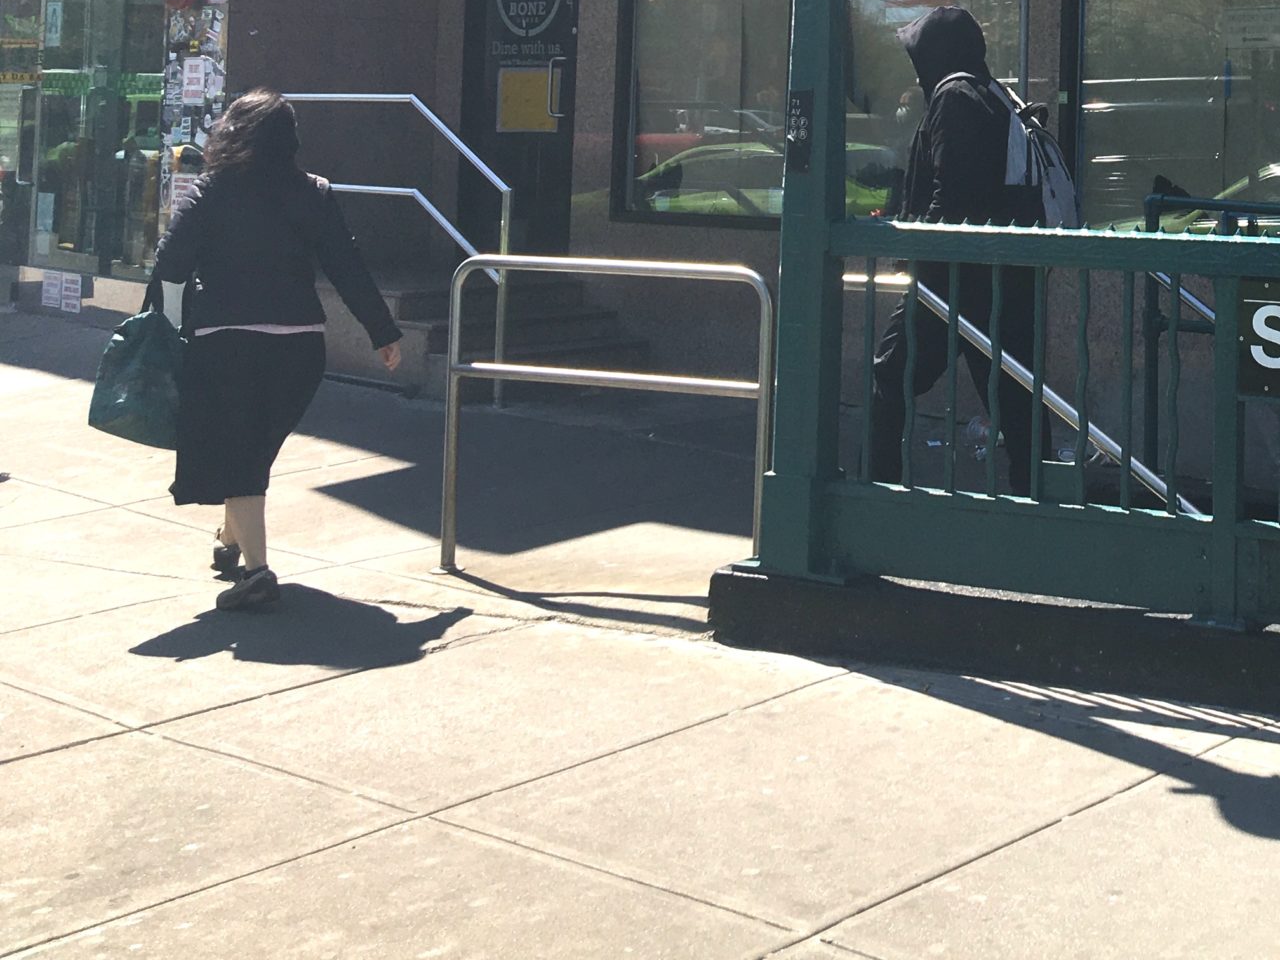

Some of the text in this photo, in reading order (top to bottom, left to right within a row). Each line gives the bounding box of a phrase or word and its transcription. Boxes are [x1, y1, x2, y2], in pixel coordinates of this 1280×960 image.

[509, 1, 546, 16] BONE
[492, 41, 564, 55] Dine with us.
[791, 98, 800, 106] 71
[791, 108, 801, 116] AV
